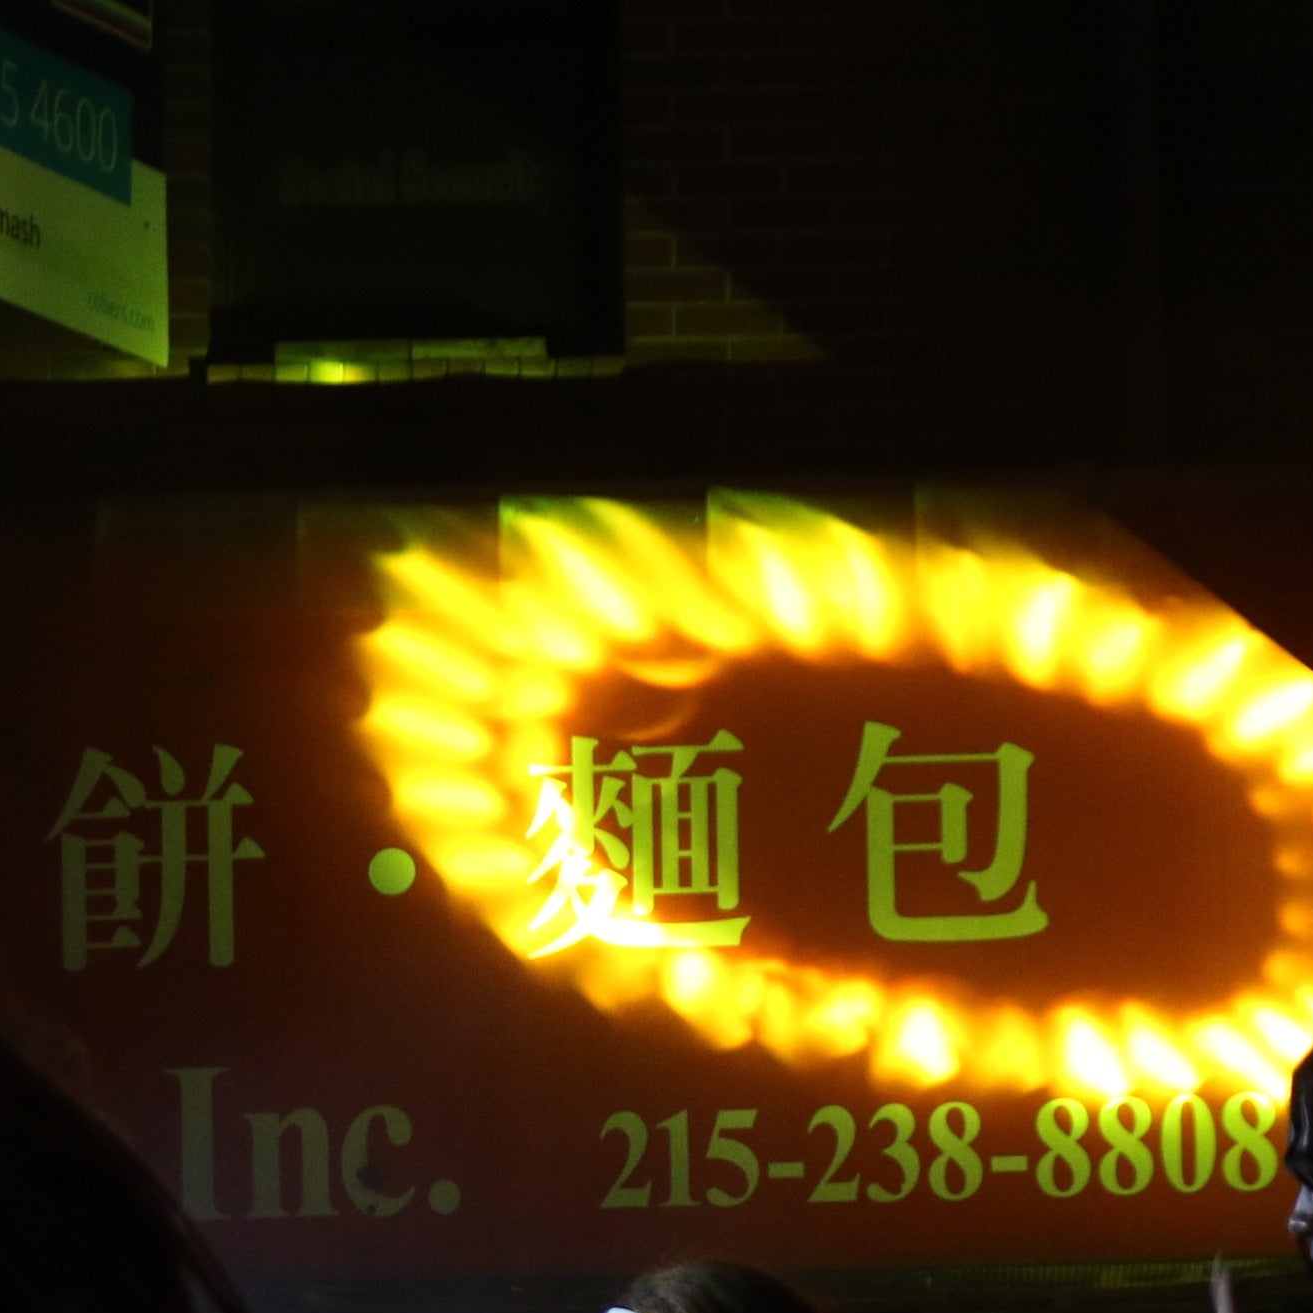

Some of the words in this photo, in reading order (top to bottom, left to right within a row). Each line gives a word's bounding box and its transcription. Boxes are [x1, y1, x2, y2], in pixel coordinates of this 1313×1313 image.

[29, 80, 118, 173] 4600
[163, 1066, 463, 1222] Inc.
[597, 1091, 1280, 1209] 215-238-8808
